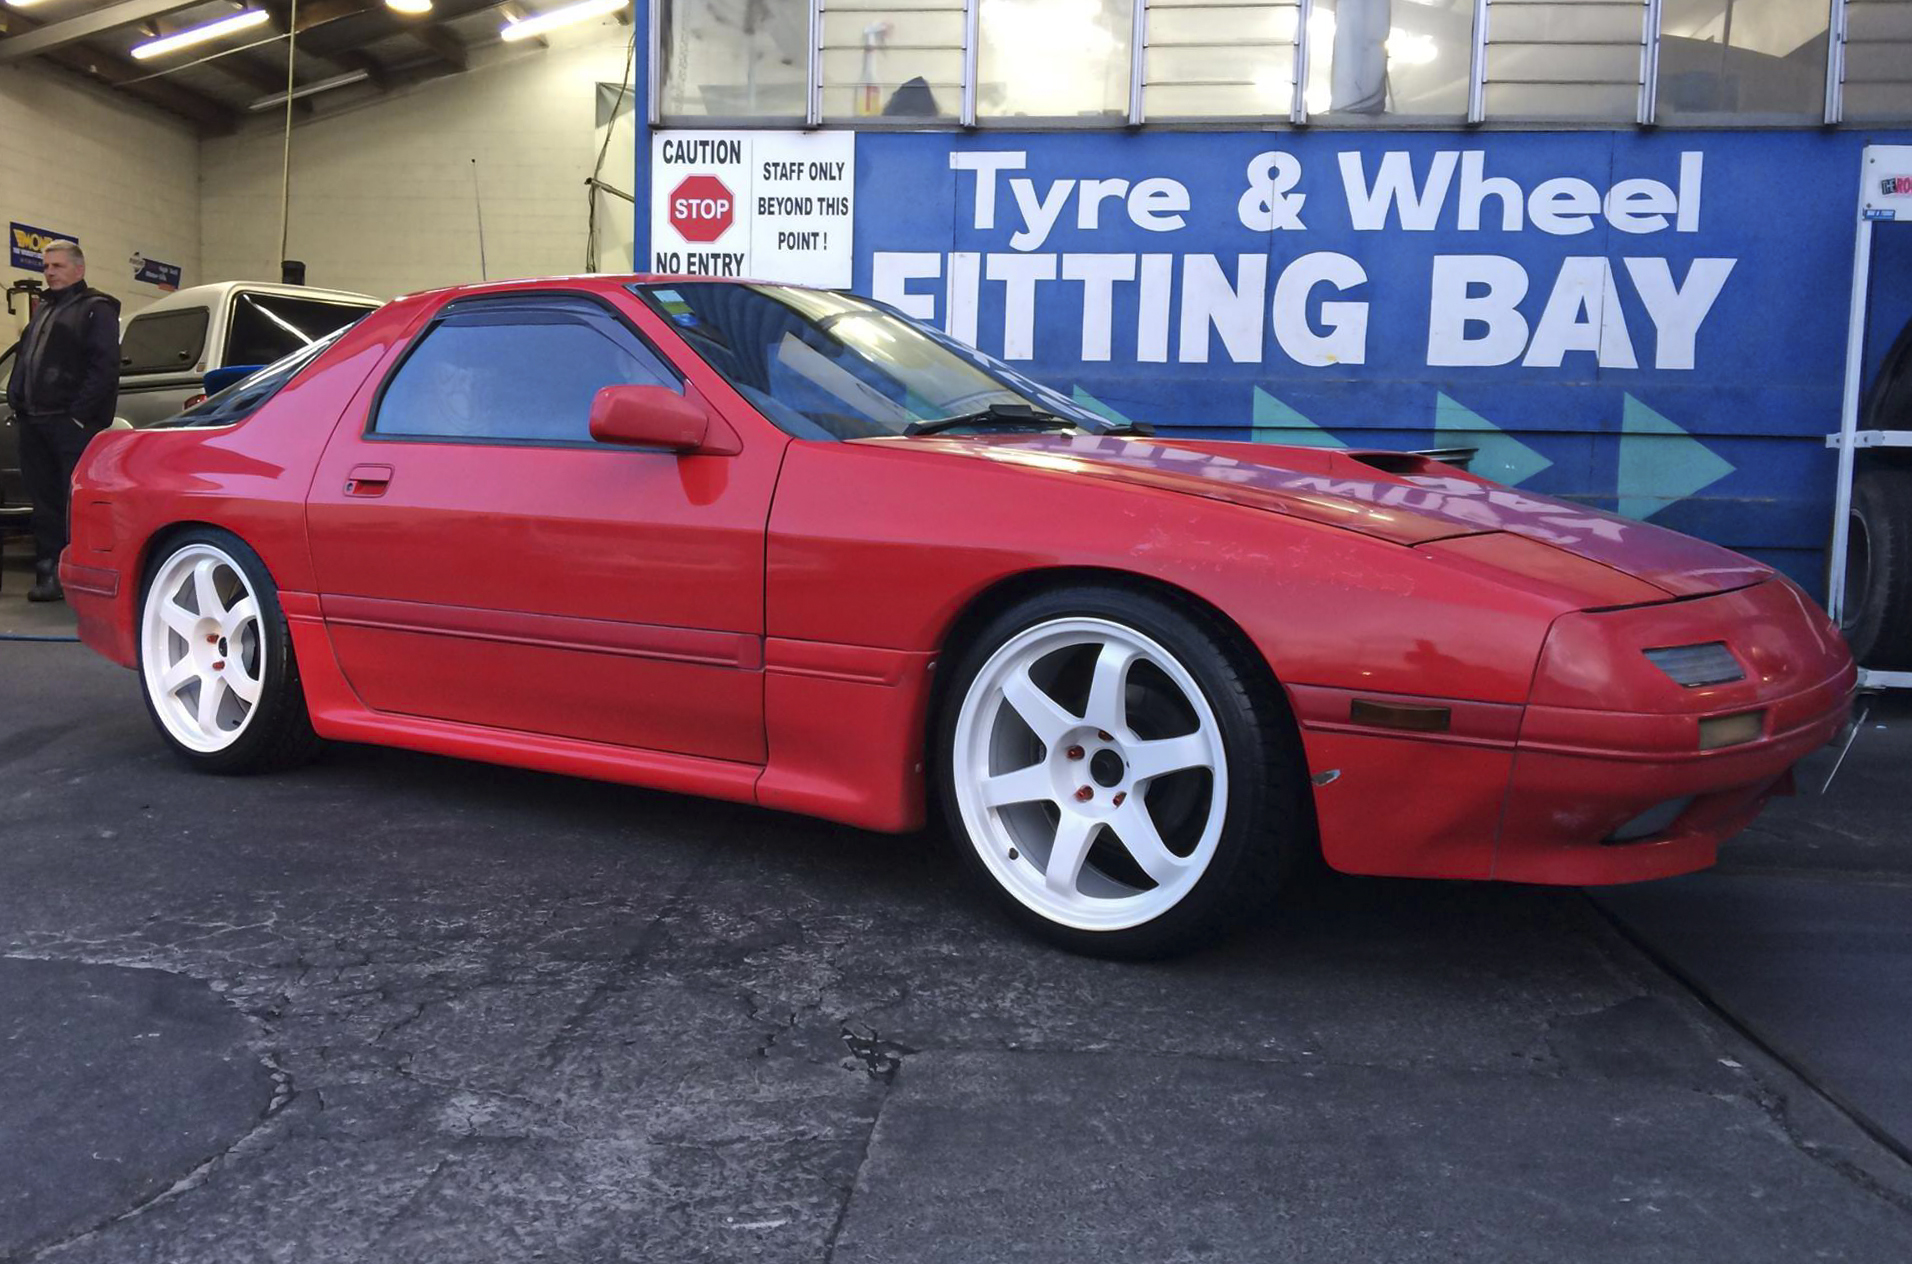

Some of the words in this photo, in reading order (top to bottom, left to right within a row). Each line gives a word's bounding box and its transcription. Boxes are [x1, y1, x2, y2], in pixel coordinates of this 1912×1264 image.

[663, 140, 741, 164] CAUTION
[763, 161, 805, 181] STAFF
[808, 161, 846, 181] ONLY
[1896, 177, 1912, 194] RO
[674, 198, 730, 220] STOP
[757, 196, 813, 216] BEYOND
[817, 196, 849, 216] THIS
[949, 150, 1191, 252] Tyre
[1238, 150, 1308, 232] &
[1337, 149, 1704, 236] Wheel
[777, 231, 820, 251] POINT
[656, 252, 681, 275] NO
[686, 252, 745, 277] ENTRY
[873, 251, 1370, 367] FITTING
[1427, 254, 1738, 370] BAY
